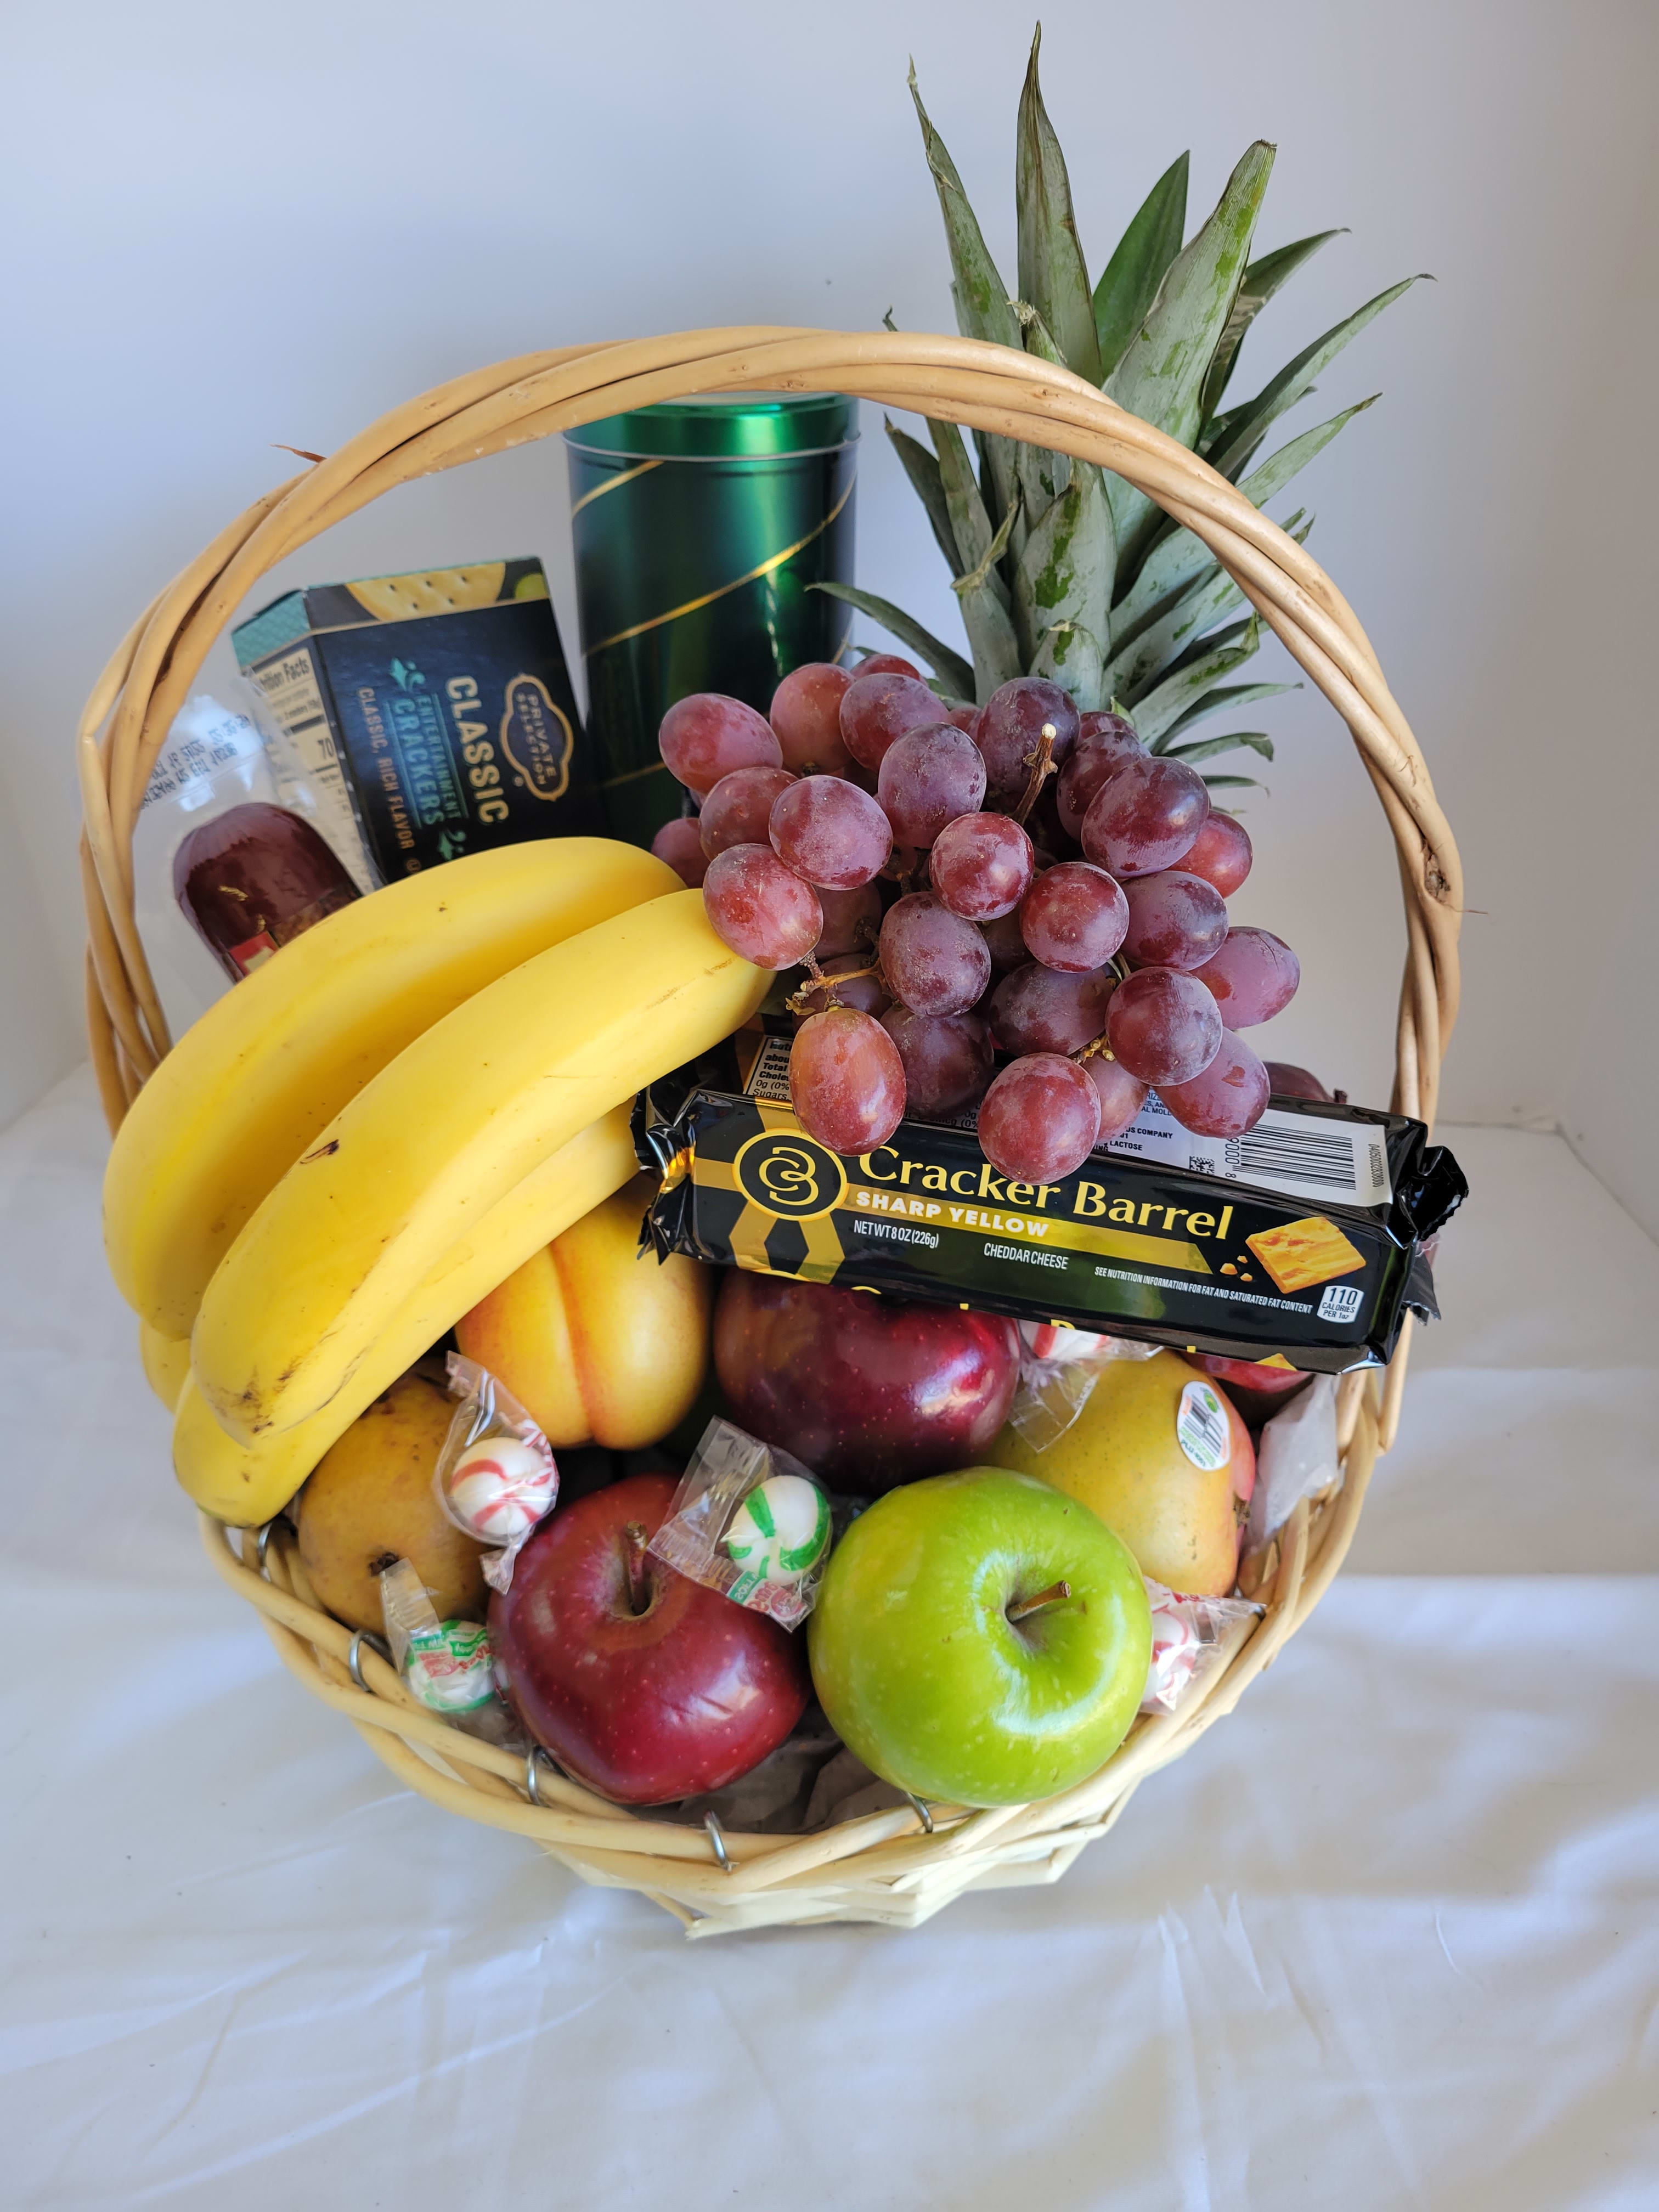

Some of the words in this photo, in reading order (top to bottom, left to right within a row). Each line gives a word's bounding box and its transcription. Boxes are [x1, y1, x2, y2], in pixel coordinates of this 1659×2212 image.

[357, 687, 388, 754] CLASSIC,
[527, 693, 556, 777] PRIVATE
[318, 738, 335, 760] 70
[393, 698, 444, 825] CRACKERS
[448, 675, 509, 823] CLASSIC
[377, 758, 400, 791] RICH
[388, 795, 415, 849] FLAVOR
[764, 1063, 787, 1071] Total
[765, 1054, 790, 1063] abou
[756, 1080, 768, 1088] 0g
[771, 1081, 789, 1090] (0%
[759, 1071, 789, 1081] Choles
[1109, 1141, 1143, 1151] LACTOSE
[1137, 1127, 1173, 1139] COMPANY
[859, 1145, 1061, 1209] Cracker
[1073, 1181, 1234, 1240] Barrel
[855, 1191, 942, 1219] SHARP
[948, 1206, 1050, 1238] YELLOW
[854, 1220, 874, 1235] NET
[873, 1223, 891, 1238] WT
[891, 1227, 898, 1240] 8
[898, 1227, 912, 1243] OZ
[911, 1229, 939, 1249] (226g)
[984, 1242, 1031, 1264] CHEDDAR
[1031, 1250, 1069, 1271] CHEESE
[1094, 1266, 1107, 1277] SEE
[1107, 1269, 1142, 1283] NUTRITION
[1143, 1276, 1189, 1292] INFORMATION
[1188, 1283, 1201, 1295] FOR
[1201, 1286, 1215, 1297] FAT
[1213, 1288, 1229, 1300] AND
[1229, 1290, 1268, 1306] SATURATED
[1267, 1297, 1282, 1309] FAT
[1280, 1300, 1314, 1314] CONTENT
[1328, 1287, 1359, 1305] 110
[1322, 1302, 1356, 1314] CALORIES
[1323, 1309, 1336, 1318] PER
[1339, 1312, 1350, 1320] 1oz
